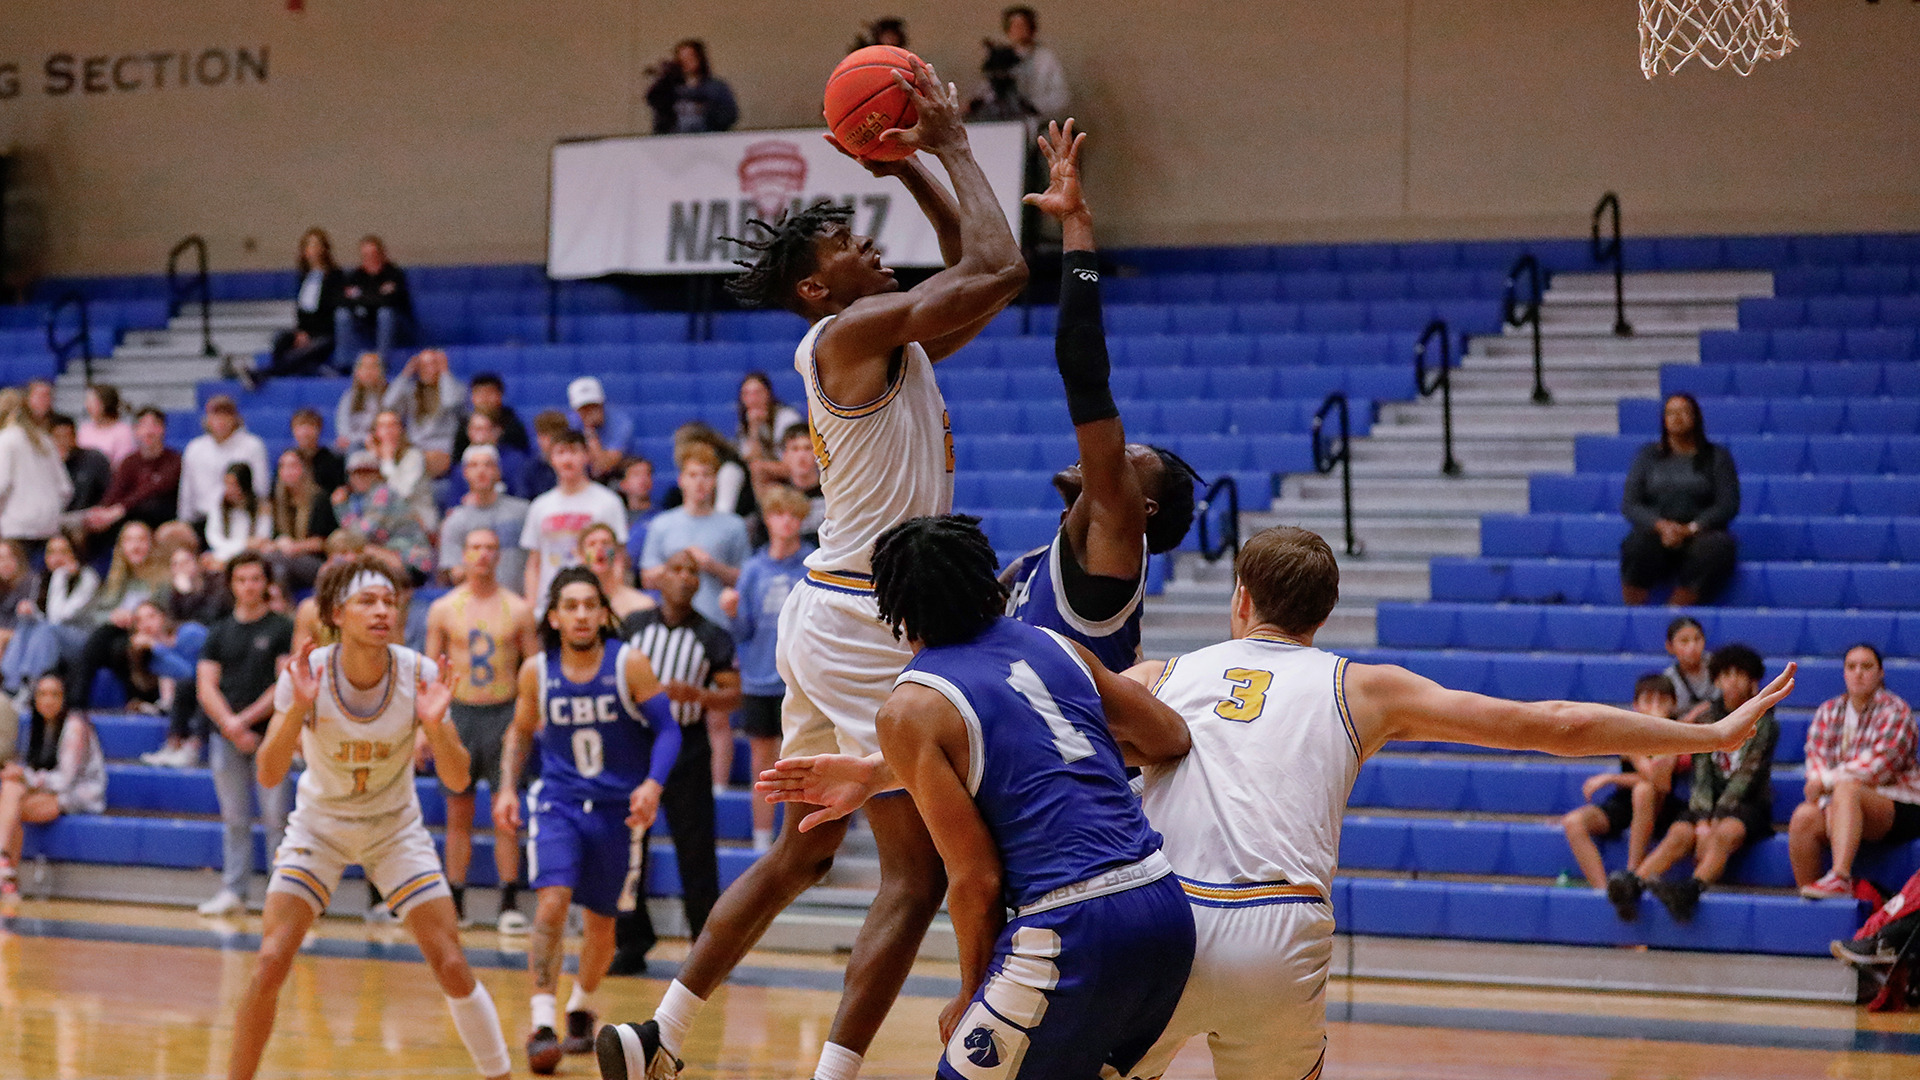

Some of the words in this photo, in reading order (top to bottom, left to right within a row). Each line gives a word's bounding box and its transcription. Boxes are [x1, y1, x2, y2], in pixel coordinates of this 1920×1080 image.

[44, 46, 271, 97] SECTION
[469, 629, 495, 688] B
[549, 694, 619, 726] CBC
[1006, 659, 1097, 764] 1
[1213, 667, 1274, 723] 3
[571, 728, 605, 779] 0
